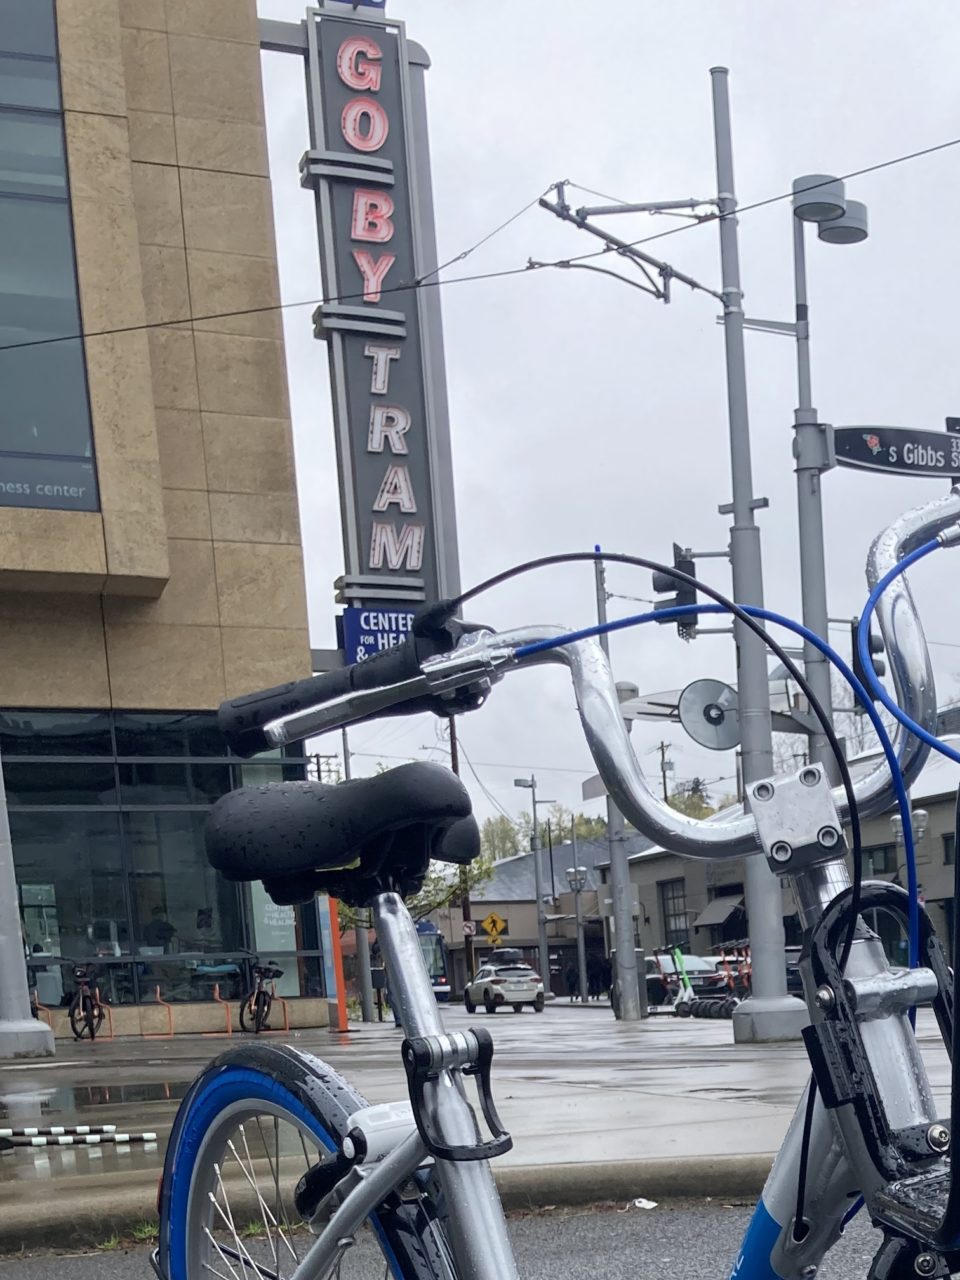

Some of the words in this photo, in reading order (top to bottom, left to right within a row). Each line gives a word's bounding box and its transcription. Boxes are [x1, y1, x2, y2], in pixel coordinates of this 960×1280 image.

[337, 36, 390, 152] GO
[350, 188, 396, 303] BY
[363, 344, 426, 571] TRAM
[889, 446, 898, 462] S
[903, 443, 945, 467] Gibbs
[36, 484, 86, 497] center
[360, 635, 375, 645] FOR
[377, 632, 407, 650] HEA
[356, 646, 369, 663] &
